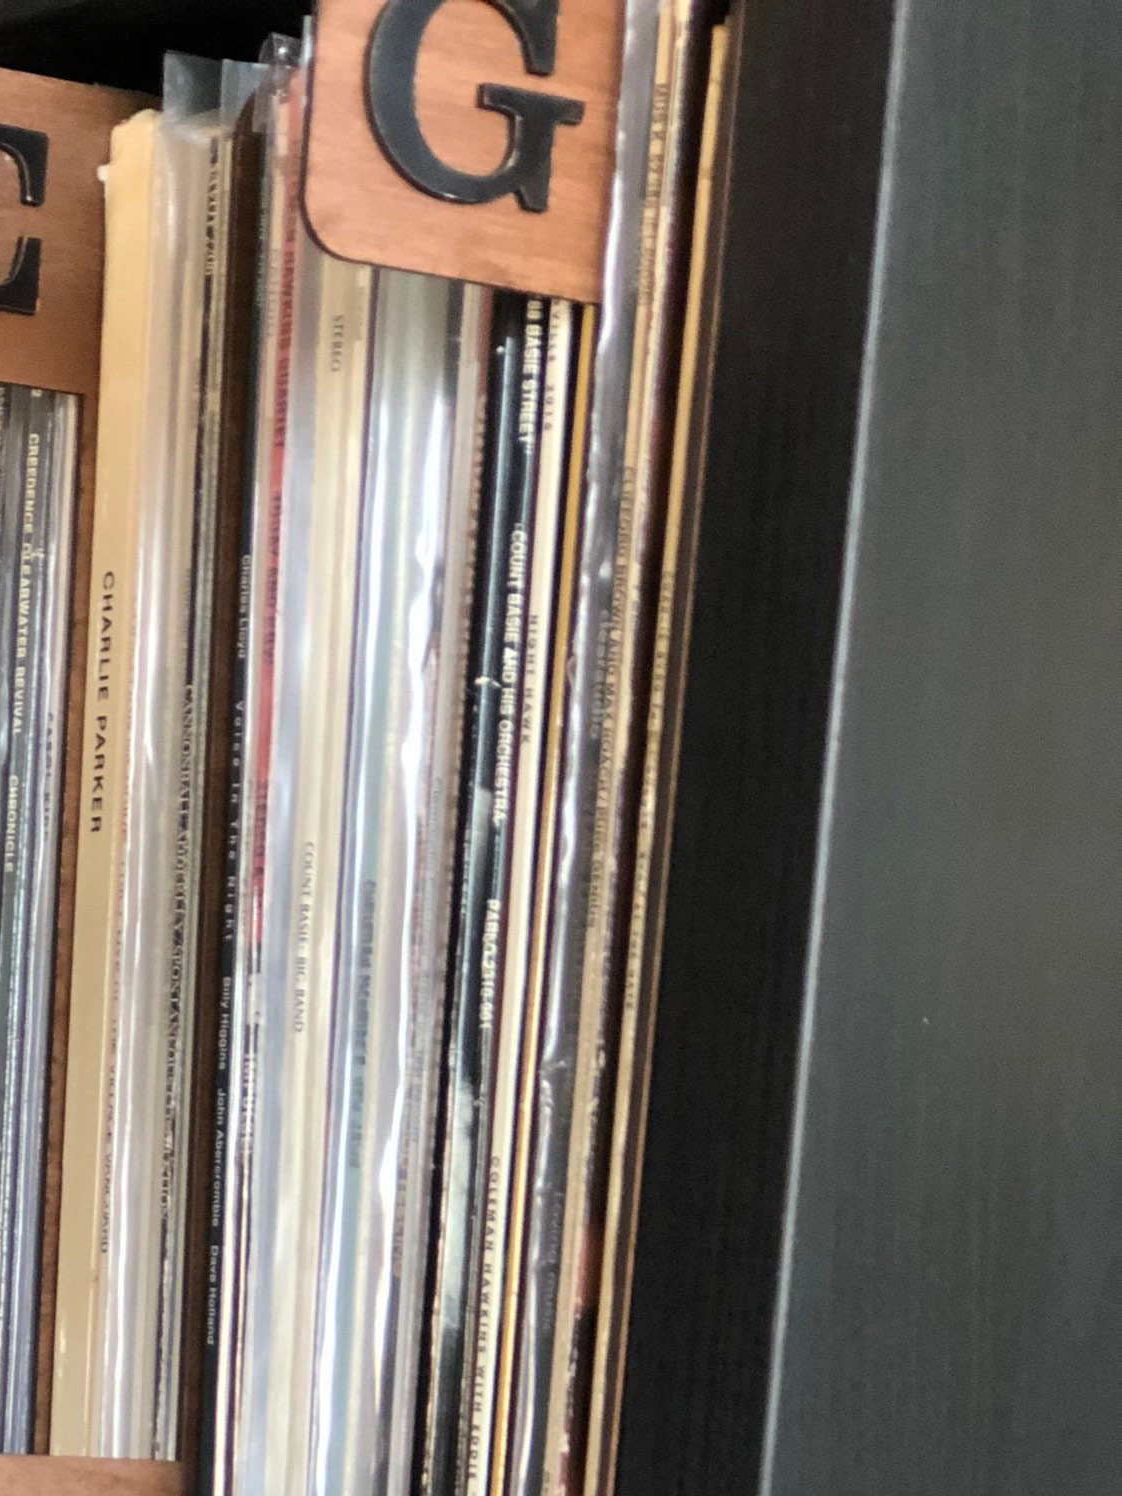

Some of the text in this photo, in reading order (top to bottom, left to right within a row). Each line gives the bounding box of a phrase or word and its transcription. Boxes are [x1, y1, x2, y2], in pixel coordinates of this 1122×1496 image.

[364, 0, 583, 213] G
[616, 466, 635, 559] CLIFFORD
[238, 555, 251, 613] Charles
[494, 324, 541, 822] BASIE COUNT BASIE AND HIS ORCHESTRA
[4, 433, 39, 873] CREEDENCE CLEARWATER REVIVAL CHRONICLE
[235, 618, 248, 659] Lloyd
[90, 570, 115, 833] CHARLIE PARKER
[299, 842, 316, 897] COUNT
[220, 976, 232, 1010] Billy
[292, 989, 306, 1034] BAND
[217, 1013, 230, 1071] Higgins
[466, 614, 539, 1480] NIGHT HAWK COLEMAN HAWKINS WITH EDDIE
[215, 1088, 227, 1127] John
[210, 1129, 225, 1228] Abercrombie
[207, 1244, 220, 1280] Dave
[205, 1286, 219, 1346] Holland
